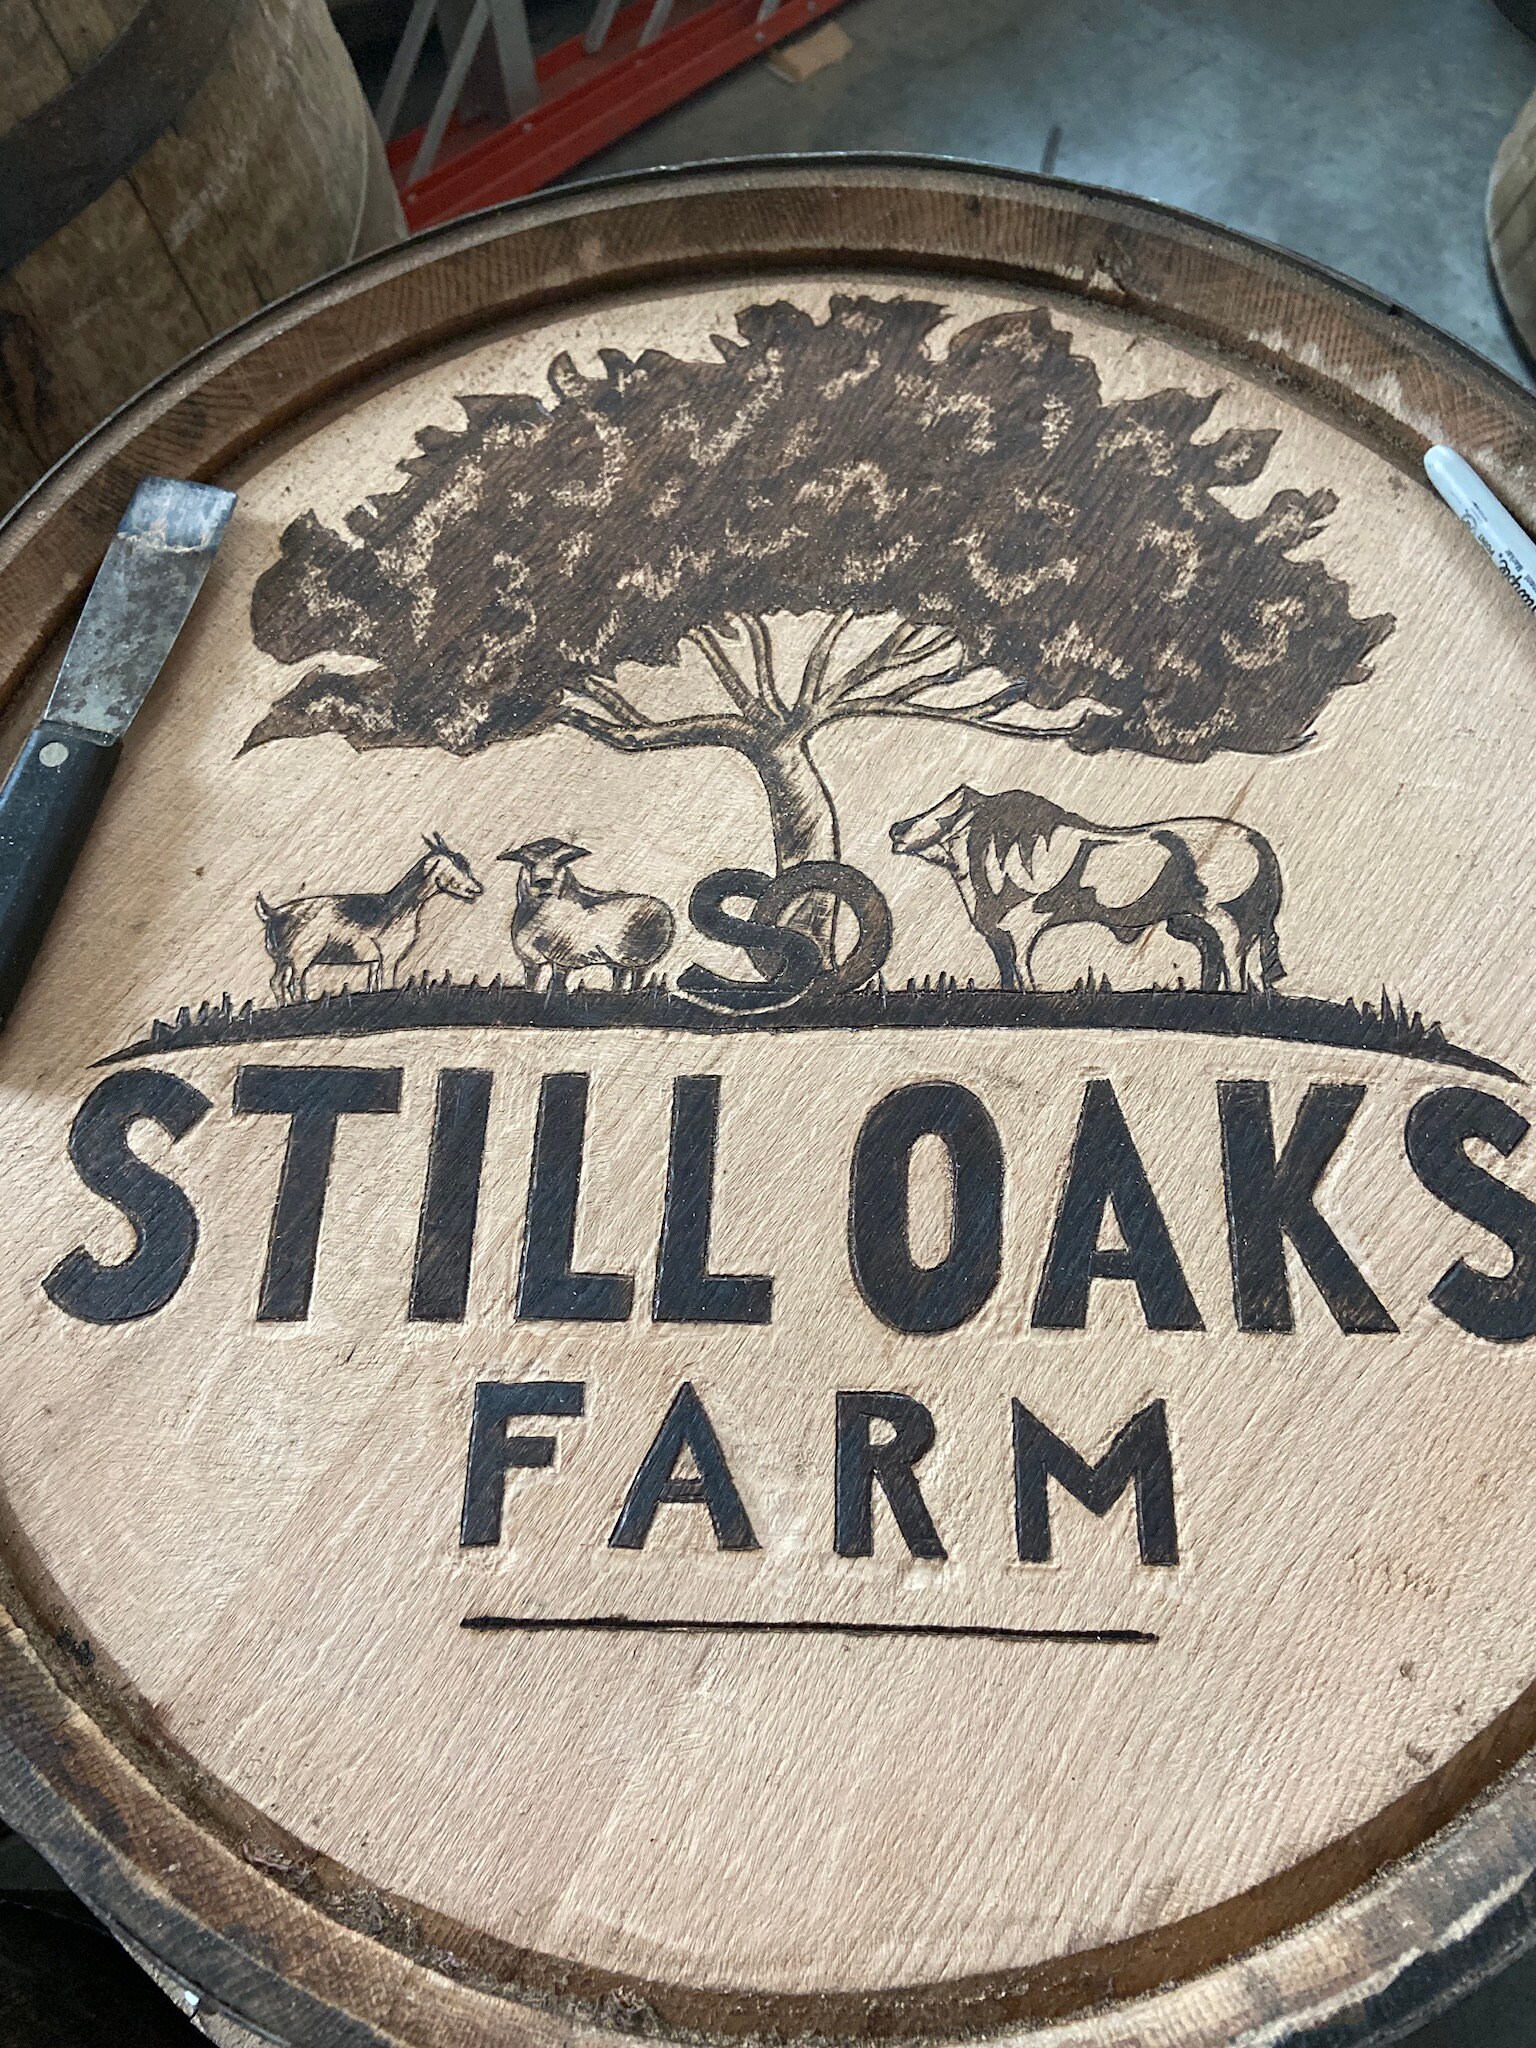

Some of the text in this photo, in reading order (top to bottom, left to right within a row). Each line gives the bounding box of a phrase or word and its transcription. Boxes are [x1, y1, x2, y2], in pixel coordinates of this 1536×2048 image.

[40, 1064, 1536, 1344] STILL OAKS
[458, 1380, 1181, 1567] FARM
